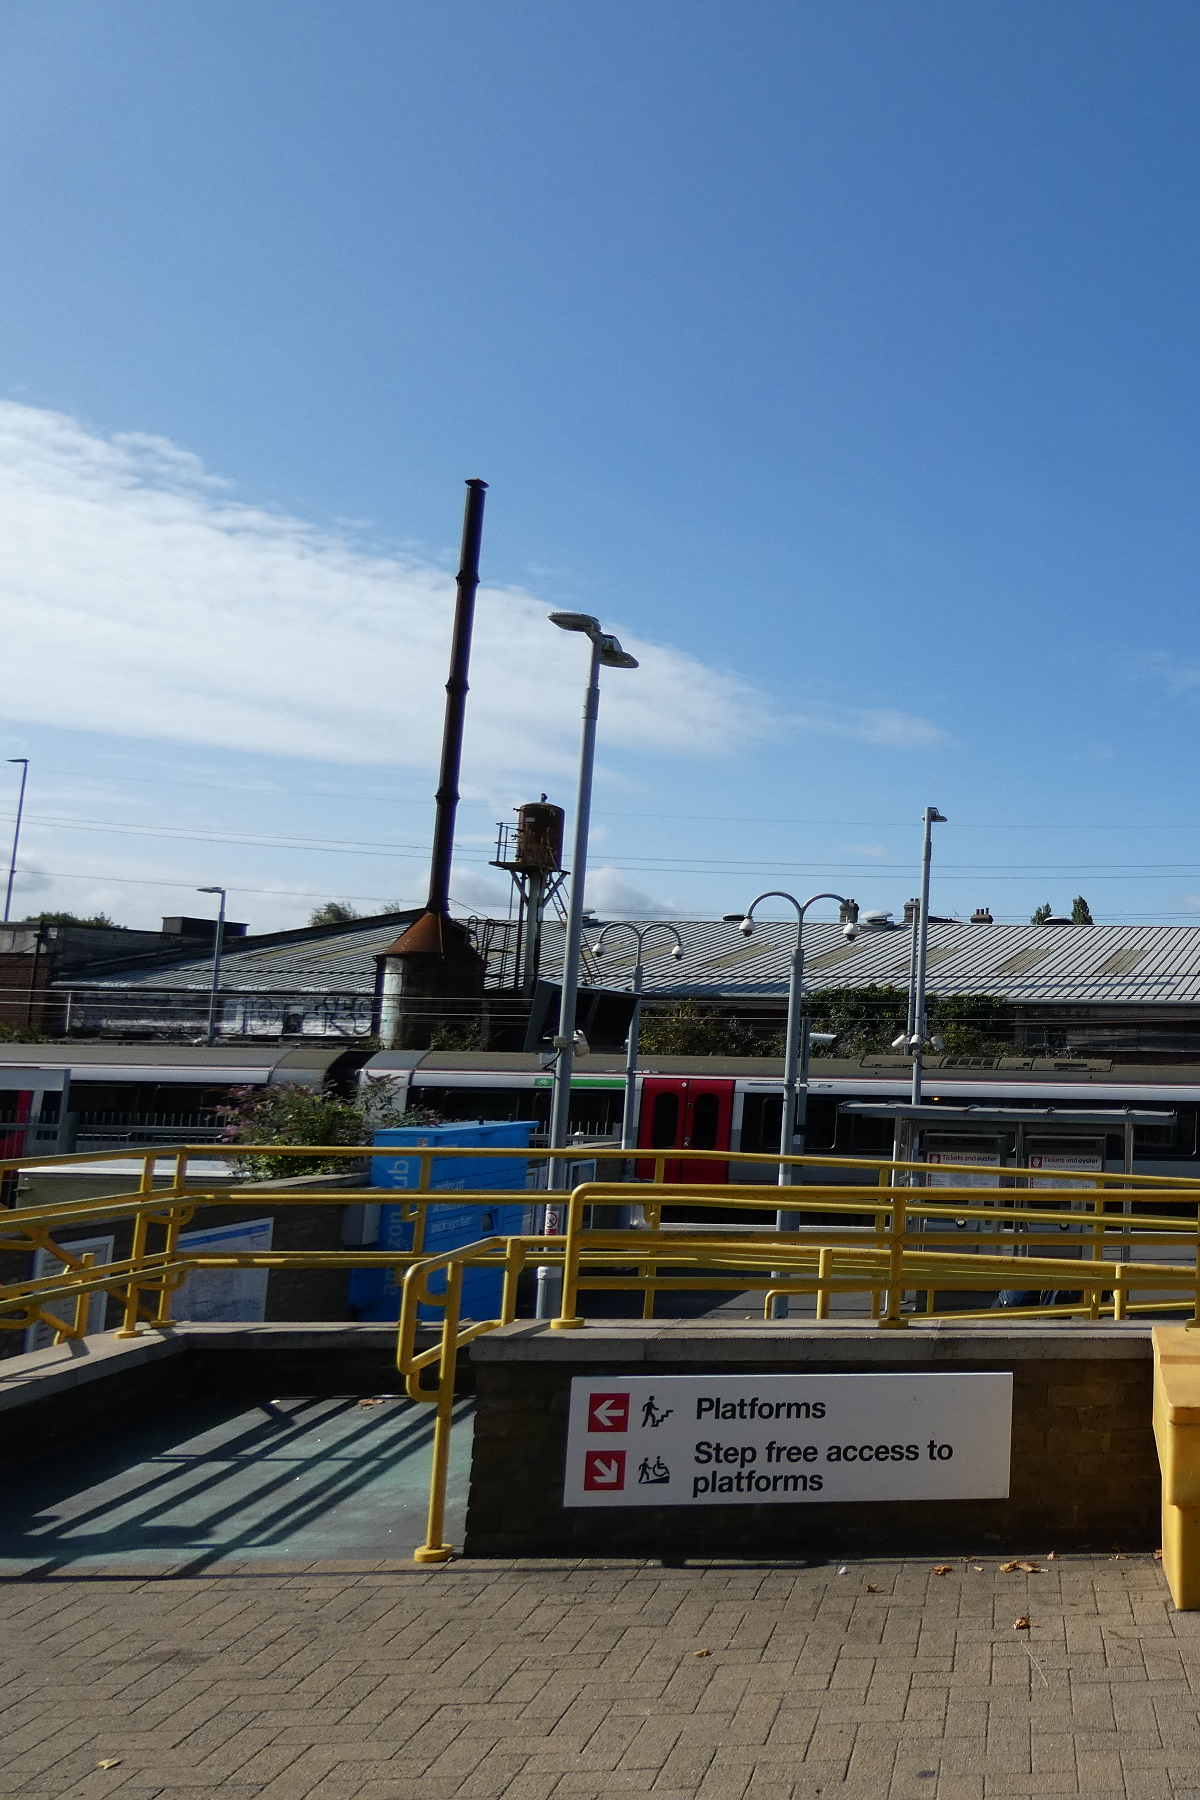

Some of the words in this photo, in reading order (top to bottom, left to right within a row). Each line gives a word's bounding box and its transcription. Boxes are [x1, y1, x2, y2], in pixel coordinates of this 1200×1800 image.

[942, 1154, 964, 1162] Tickets
[964, 1154, 976, 1162] and
[976, 1155, 998, 1163] oyster
[1078, 1157, 1099, 1165] oyster
[696, 1397, 827, 1421] Platforms
[694, 1441, 757, 1468] Step
[766, 1440, 818, 1463] free
[826, 1442, 919, 1463] access
[927, 1439, 954, 1462] to
[692, 1470, 824, 1498] platforms
